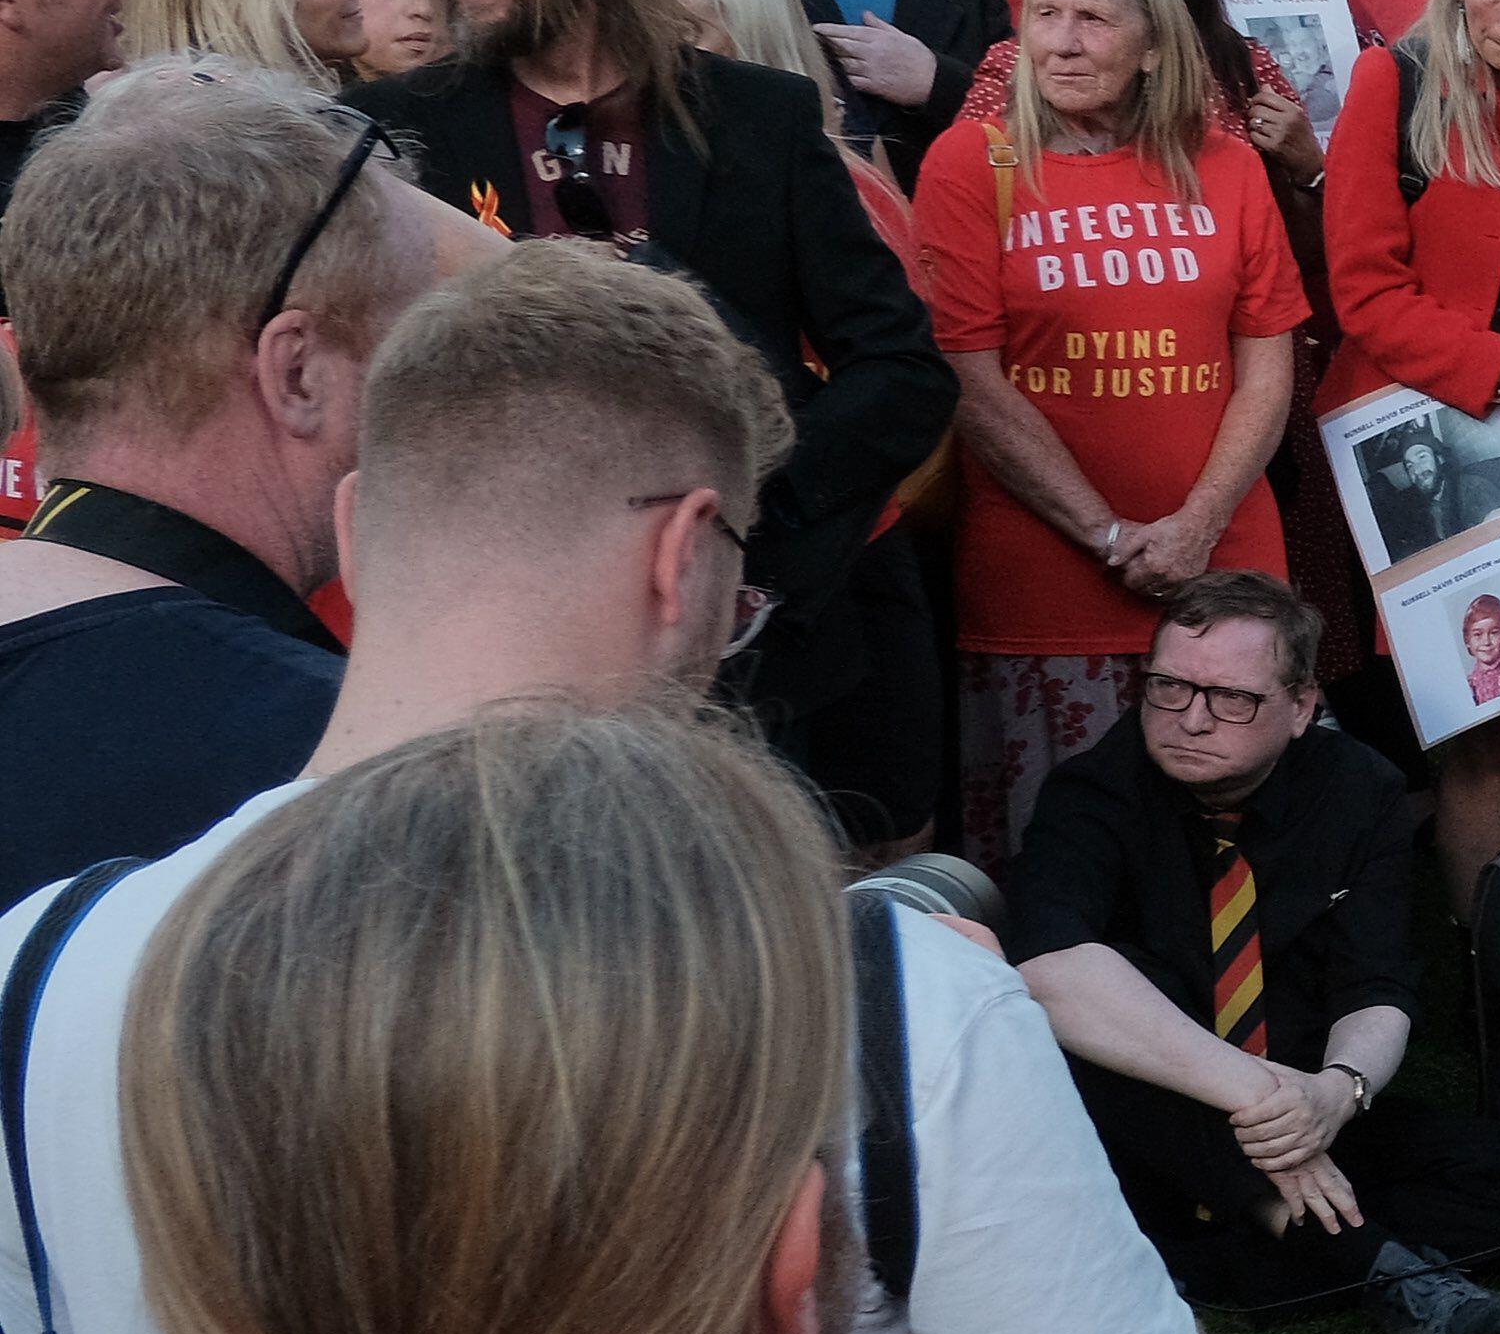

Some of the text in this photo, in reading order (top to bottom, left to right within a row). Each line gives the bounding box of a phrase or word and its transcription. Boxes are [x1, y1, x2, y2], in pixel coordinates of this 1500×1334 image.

[1004, 202, 1218, 252] INFECTED
[1036, 246, 1200, 292] BLOOD
[1065, 327, 1178, 360] DYING
[1008, 360, 1223, 398] FOR JUSTICE
